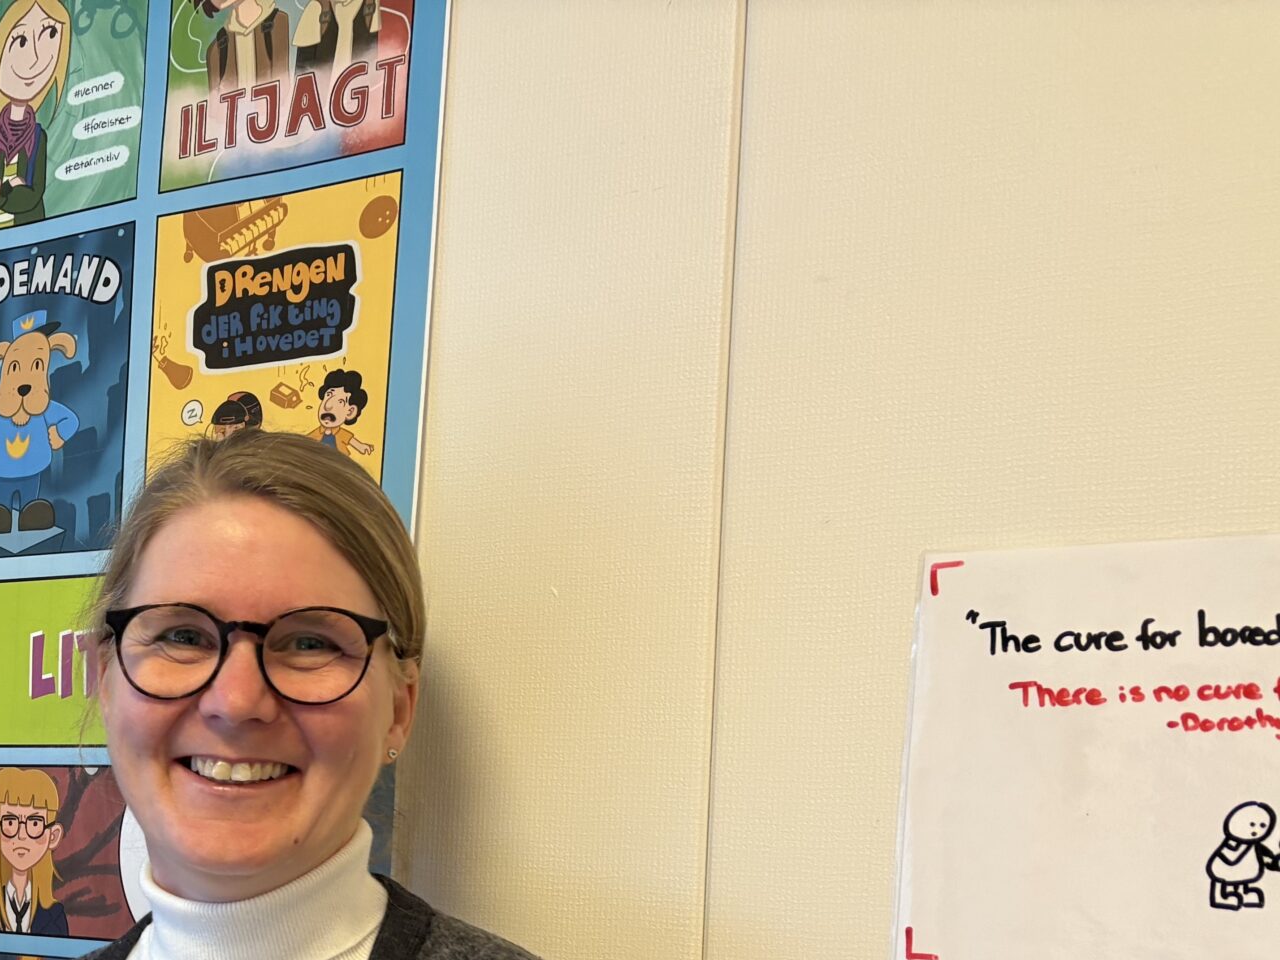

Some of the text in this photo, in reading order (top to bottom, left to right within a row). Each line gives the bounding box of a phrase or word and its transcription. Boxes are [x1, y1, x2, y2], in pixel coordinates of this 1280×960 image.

[179, 55, 405, 159] ILTJAGT
[1054, 630, 1128, 652] cure
[1136, 617, 1182, 651] for
[1008, 680, 1107, 708] There
[1118, 685, 1146, 703] is
[1153, 684, 1190, 702] no
[1197, 682, 1263, 701] cure
